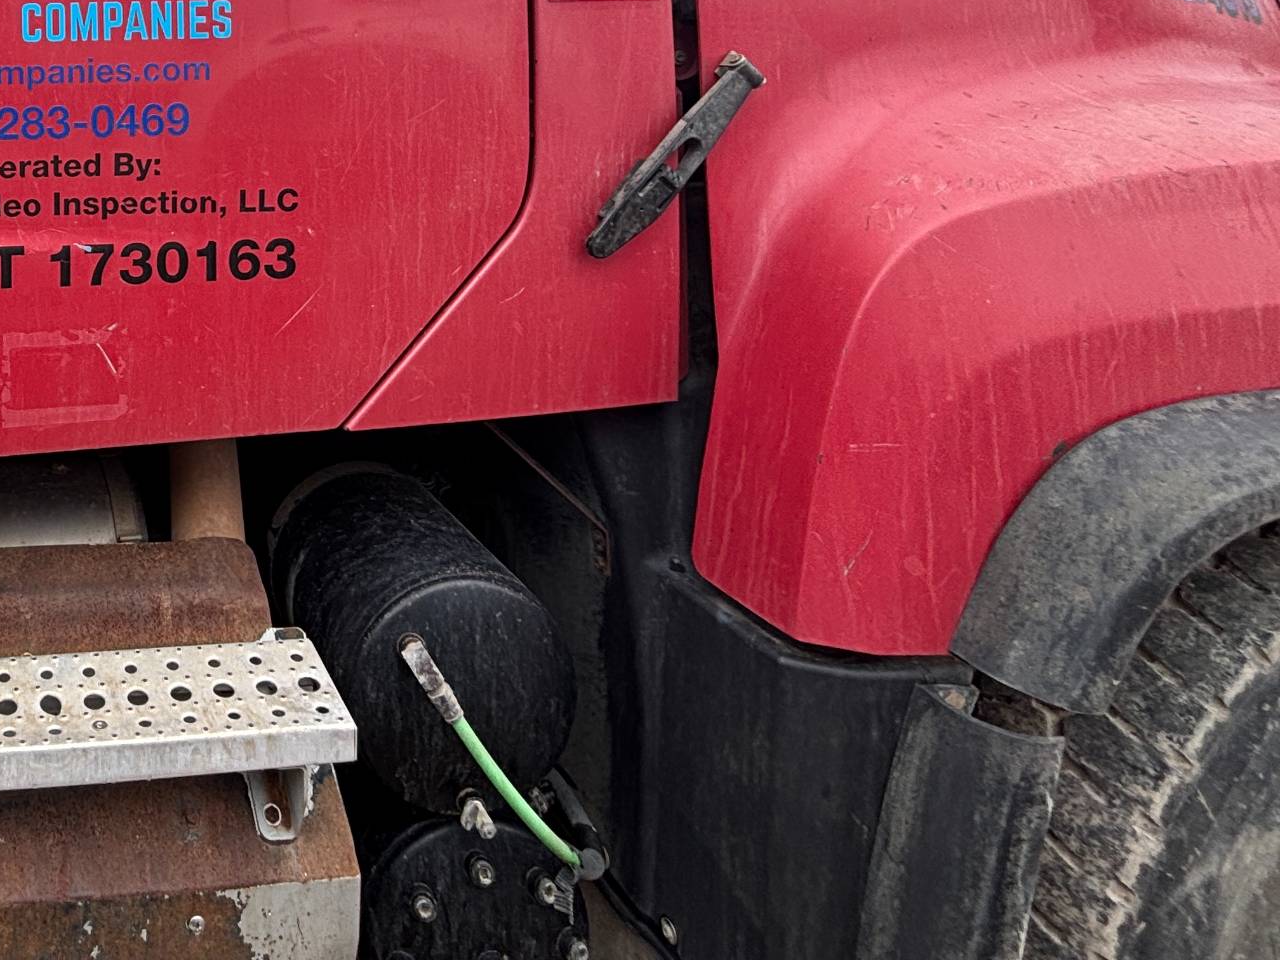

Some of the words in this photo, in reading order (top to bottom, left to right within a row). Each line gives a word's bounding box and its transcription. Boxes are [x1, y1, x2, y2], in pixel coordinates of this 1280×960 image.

[22, 0, 233, 42] COMPANIES
[112, 152, 162, 178] By:
[52, 189, 227, 220] Inspection,
[238, 187, 300, 214] LLC
[49, 237, 298, 289] 1730163
